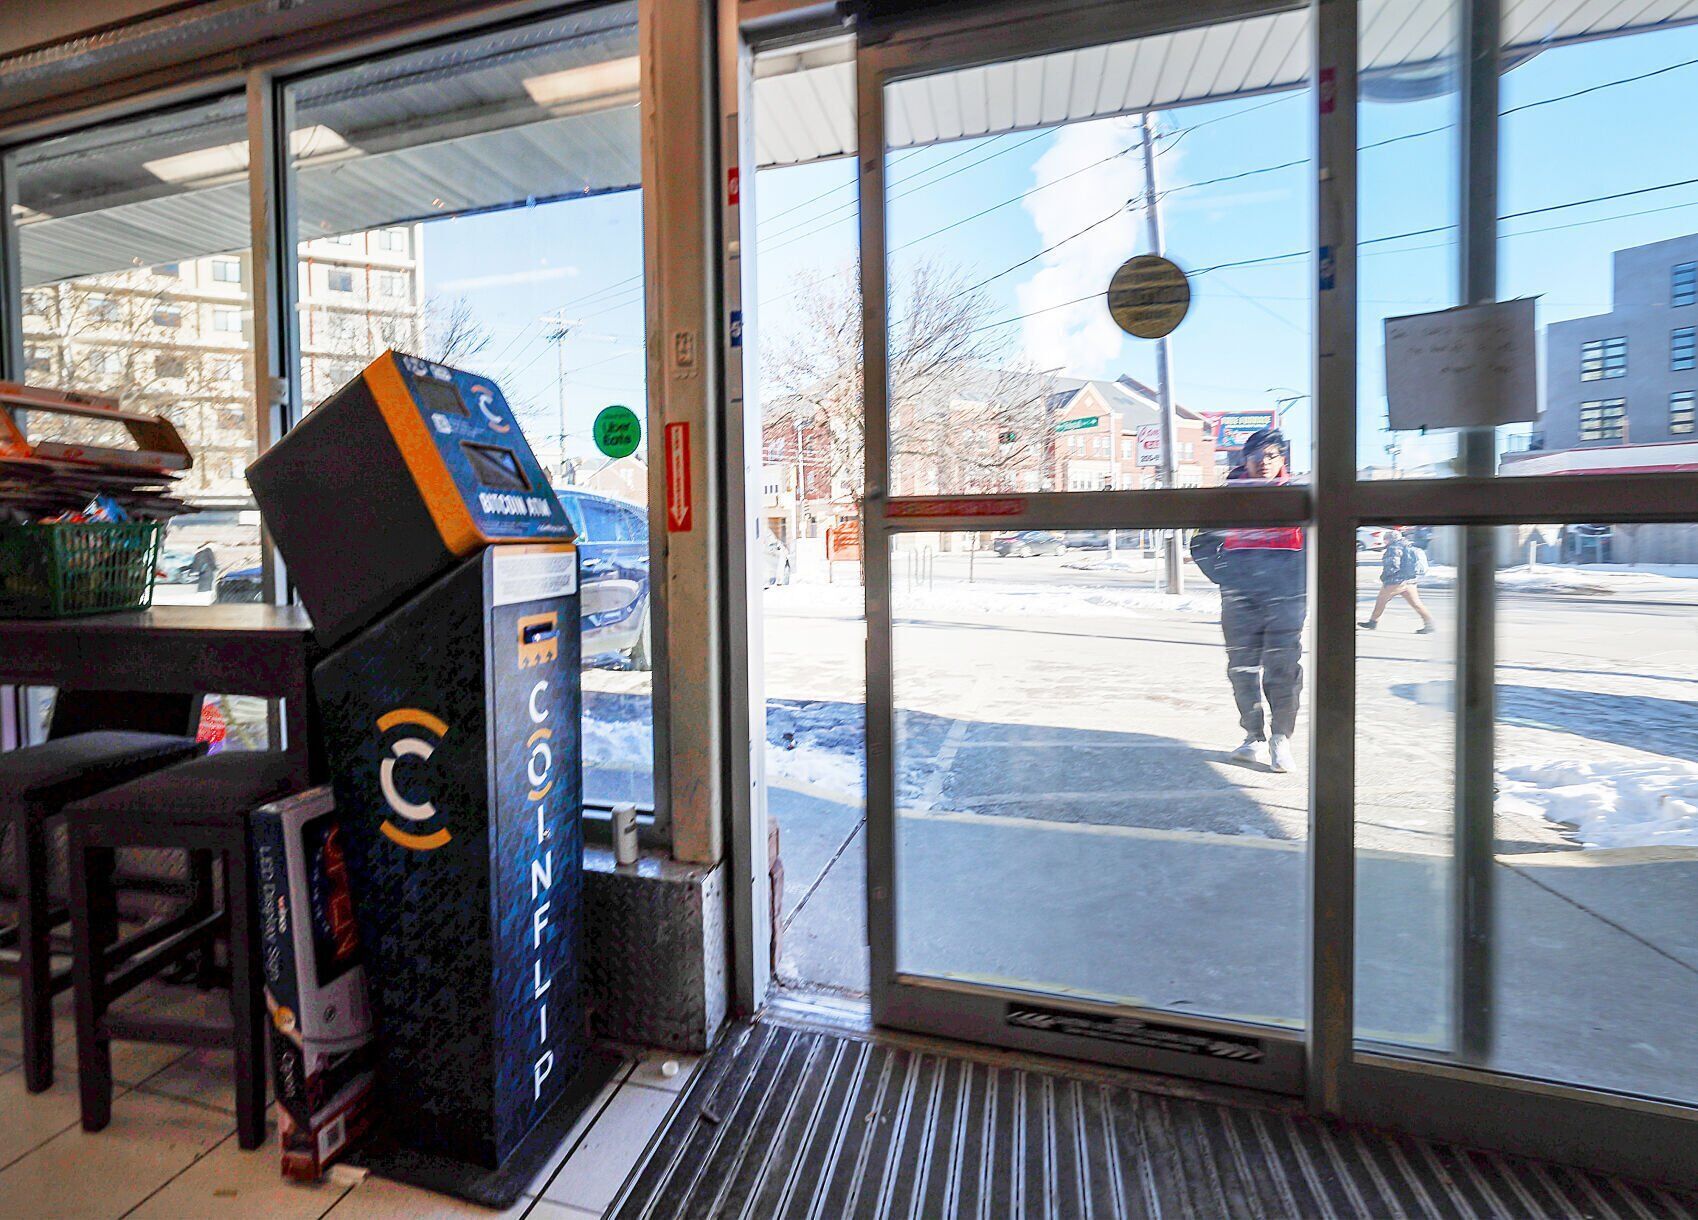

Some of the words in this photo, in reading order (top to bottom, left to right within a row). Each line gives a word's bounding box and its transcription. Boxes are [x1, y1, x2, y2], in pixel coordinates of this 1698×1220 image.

[478, 492, 528, 516] BITCOIN
[527, 497, 552, 517] ATM
[527, 680, 554, 1102] COINFLIP
